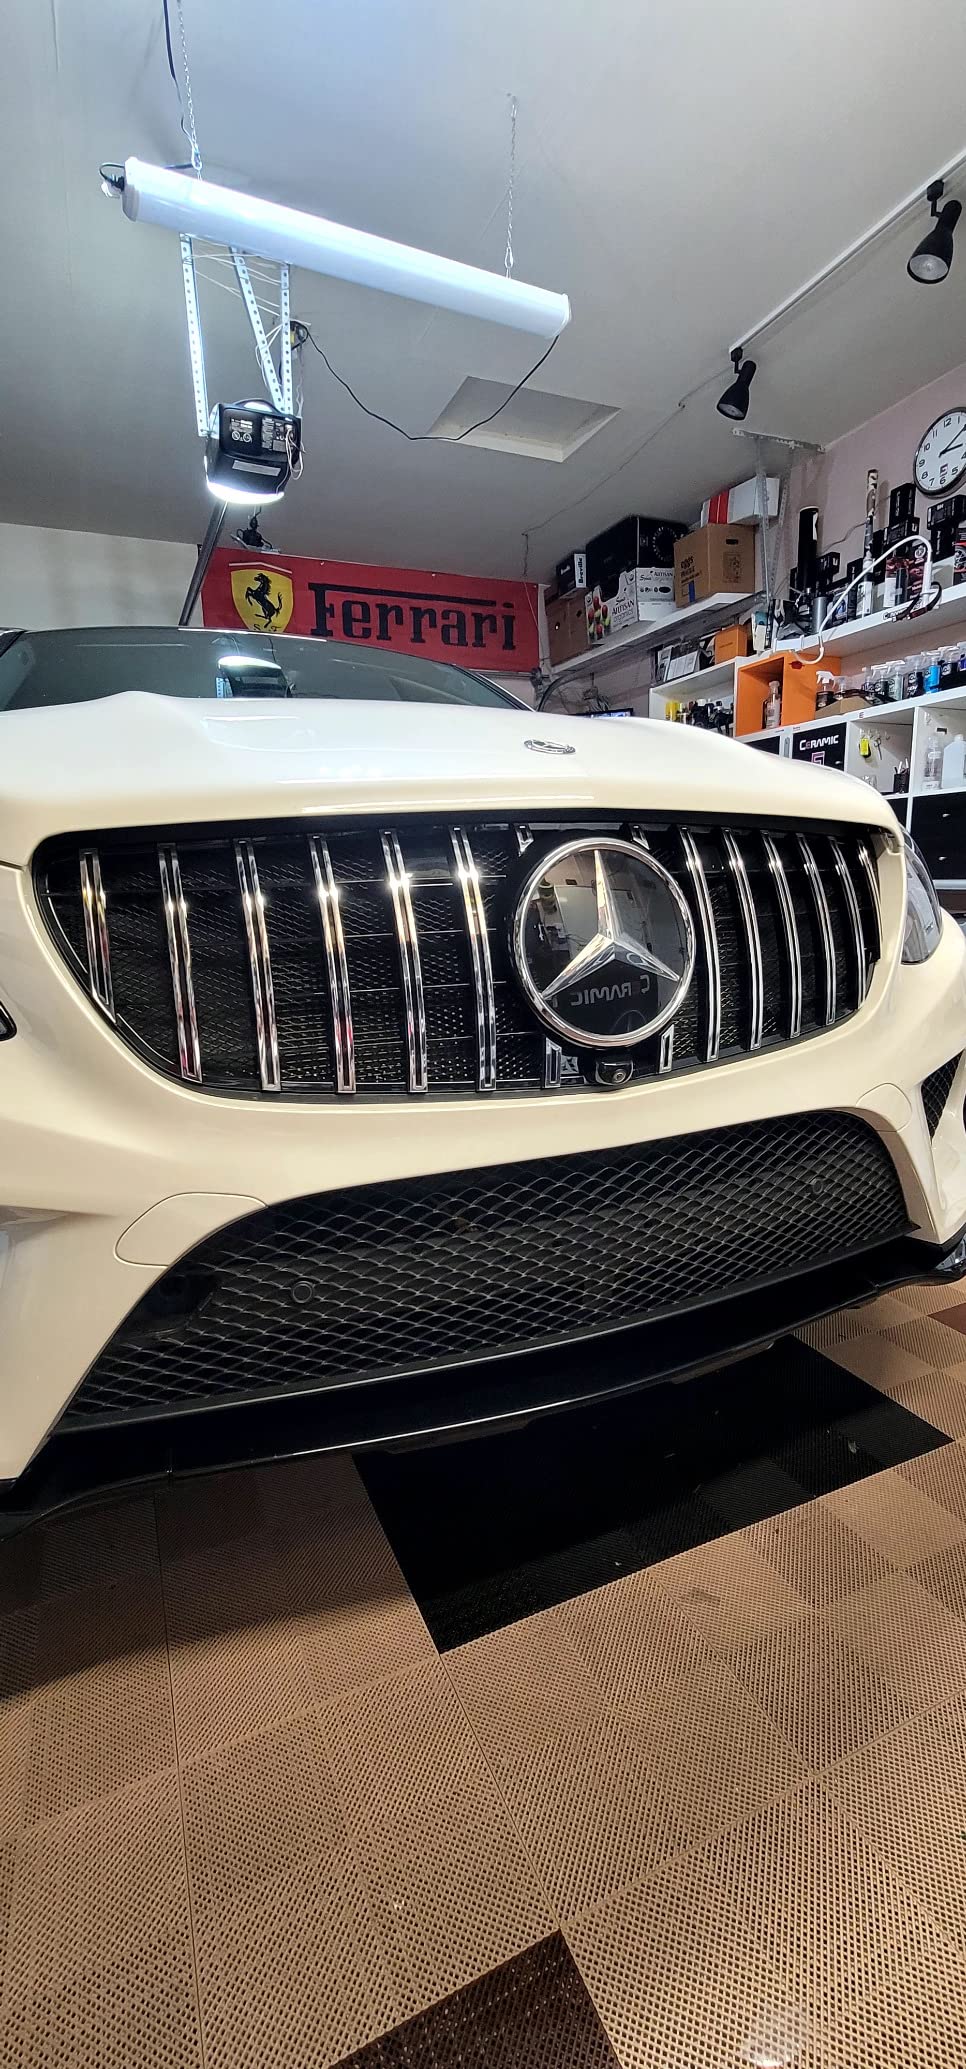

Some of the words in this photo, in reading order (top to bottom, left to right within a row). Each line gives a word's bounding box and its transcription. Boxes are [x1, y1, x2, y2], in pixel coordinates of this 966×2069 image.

[943, 418, 951, 428] 12
[924, 443, 930, 452] 10
[919, 459, 925, 467] 9
[952, 466, 958, 475] 5
[922, 471, 928, 479] 8
[929, 478, 934, 486] 7
[940, 476, 946, 484] 6
[308, 582, 516, 651] Ferrari
